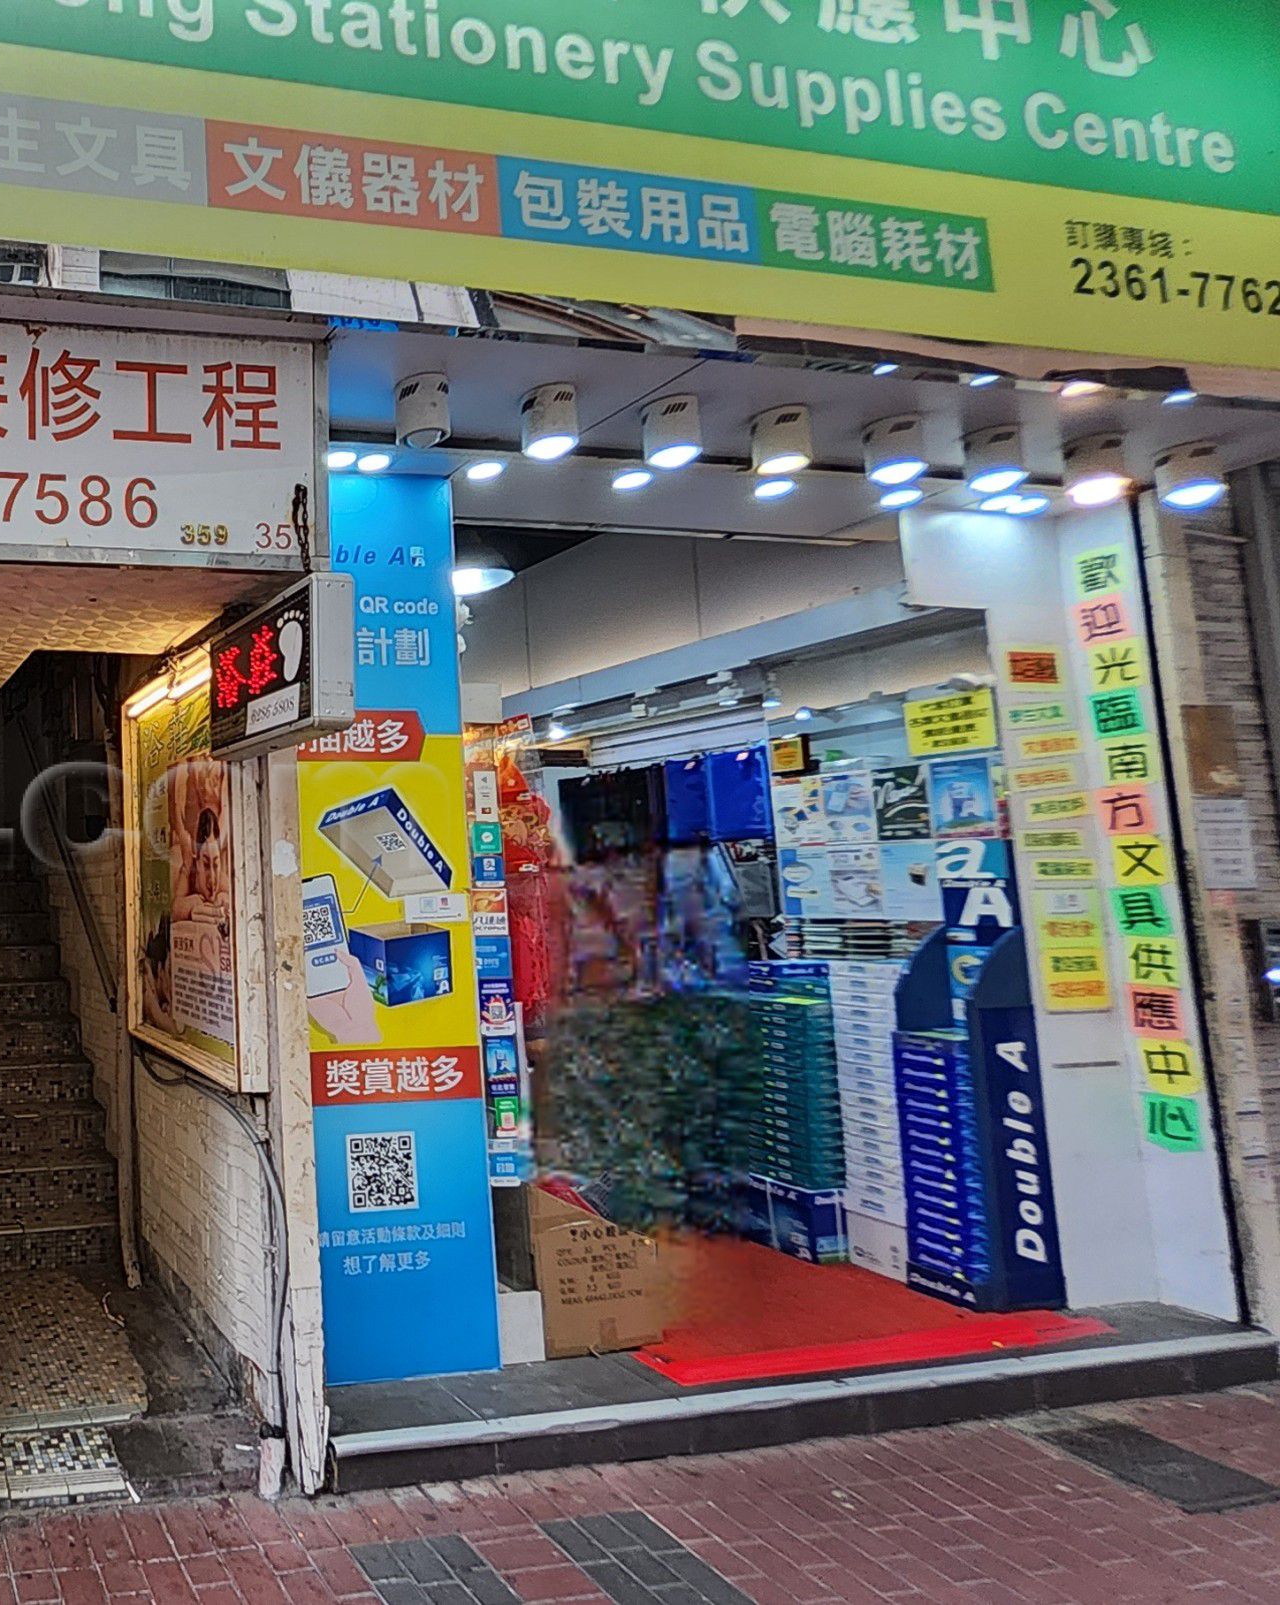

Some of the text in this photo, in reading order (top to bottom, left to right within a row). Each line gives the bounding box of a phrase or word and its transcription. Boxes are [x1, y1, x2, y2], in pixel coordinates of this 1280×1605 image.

[245, 0, 673, 106] Stationery
[696, 39, 1007, 142] Supplies
[1024, 91, 1236, 174] Centre
[223, 136, 485, 223] 文儀器材
[513, 170, 750, 254] 包裝用品
[770, 202, 981, 281] 電腦耗材
[180, 523, 228, 546] 359
[360, 596, 439, 615] QR code
[357, 627, 431, 666] 計劃
[396, 808, 434, 860] Double
[326, 1055, 463, 1097] 獎賞越多
[995, 1041, 1029, 1073] A
[343, 1250, 432, 1276] 想了解更多
